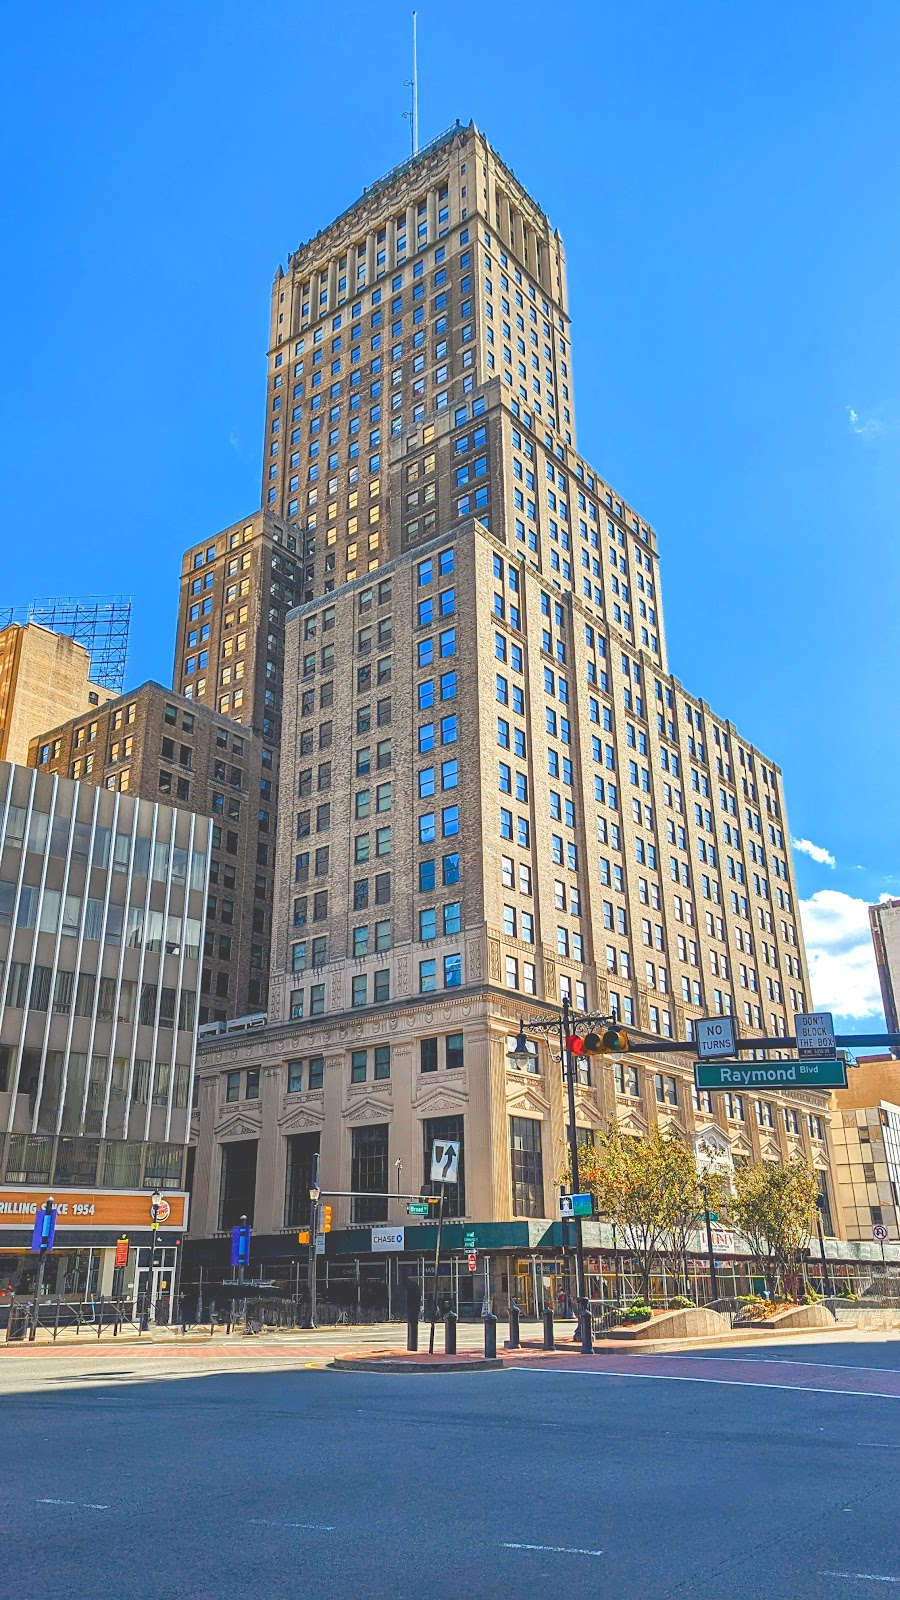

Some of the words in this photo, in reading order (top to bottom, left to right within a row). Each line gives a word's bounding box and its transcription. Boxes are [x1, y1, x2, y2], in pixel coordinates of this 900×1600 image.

[802, 1017, 824, 1026] DON'T
[707, 1024, 723, 1036] NO
[802, 1027, 828, 1037] BLOCK
[701, 1040, 732, 1051] TURNS
[799, 1038, 814, 1048] THE
[817, 1037, 834, 1047] BOX
[720, 1066, 797, 1085] Raymond
[799, 1065, 819, 1074] Blvd
[72, 1203, 96, 1216] 1954
[373, 1235, 396, 1243] CHASE
